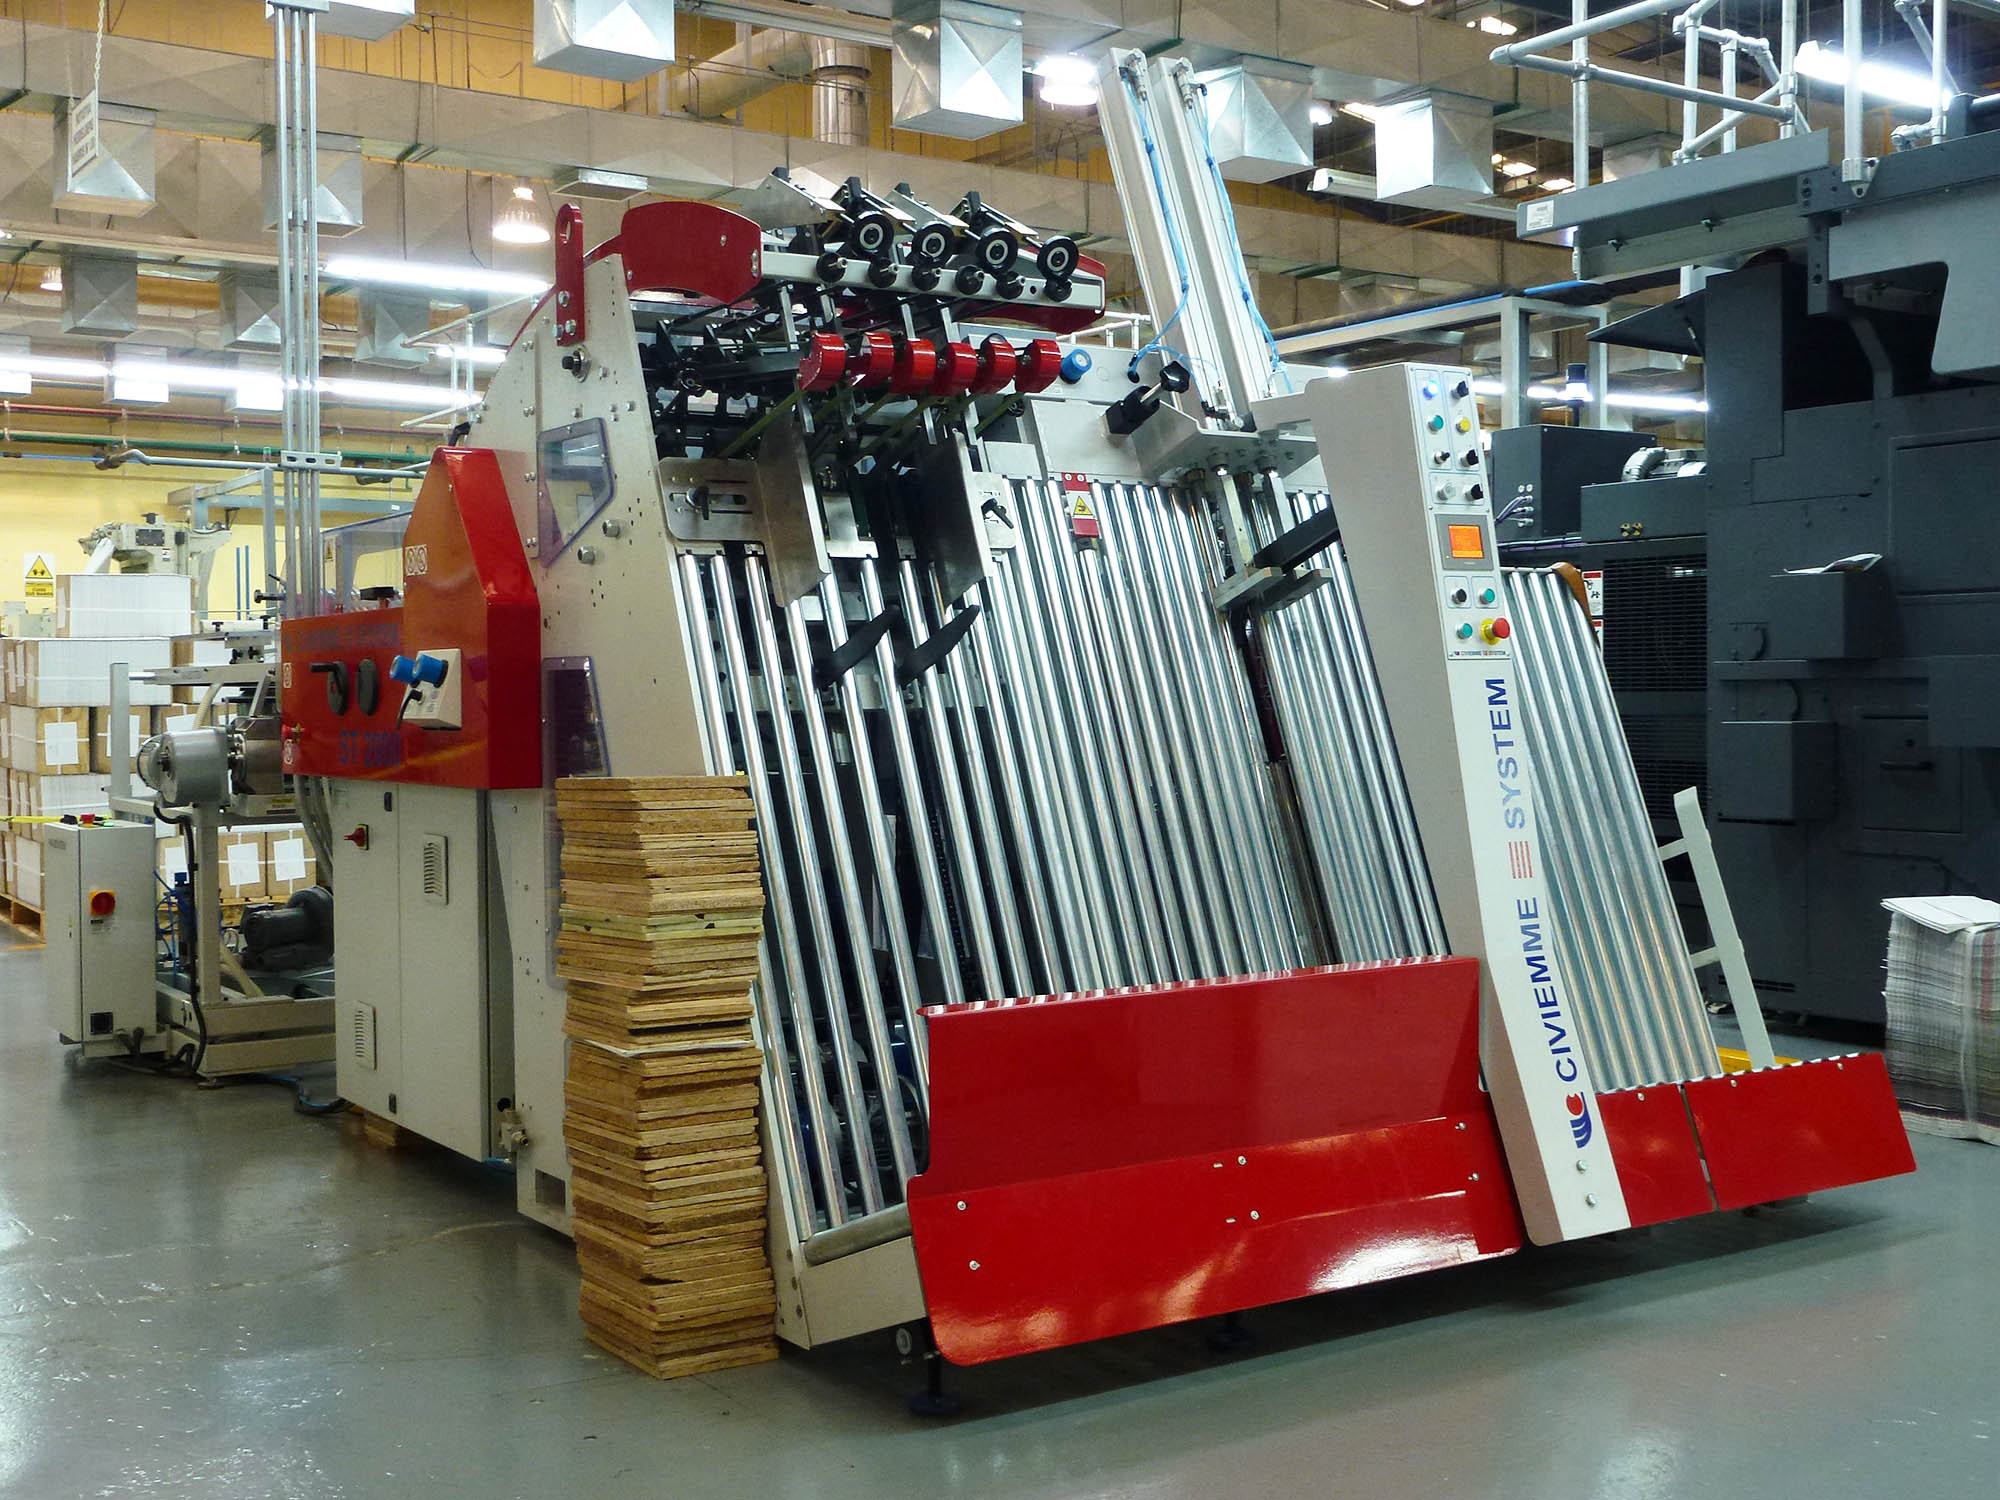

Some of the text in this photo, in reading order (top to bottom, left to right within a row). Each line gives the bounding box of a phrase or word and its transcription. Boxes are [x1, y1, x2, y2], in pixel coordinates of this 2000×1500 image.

[340, 729, 360, 765] ST
[1485, 679, 1578, 1082] CIVIEMME SYSTEM
